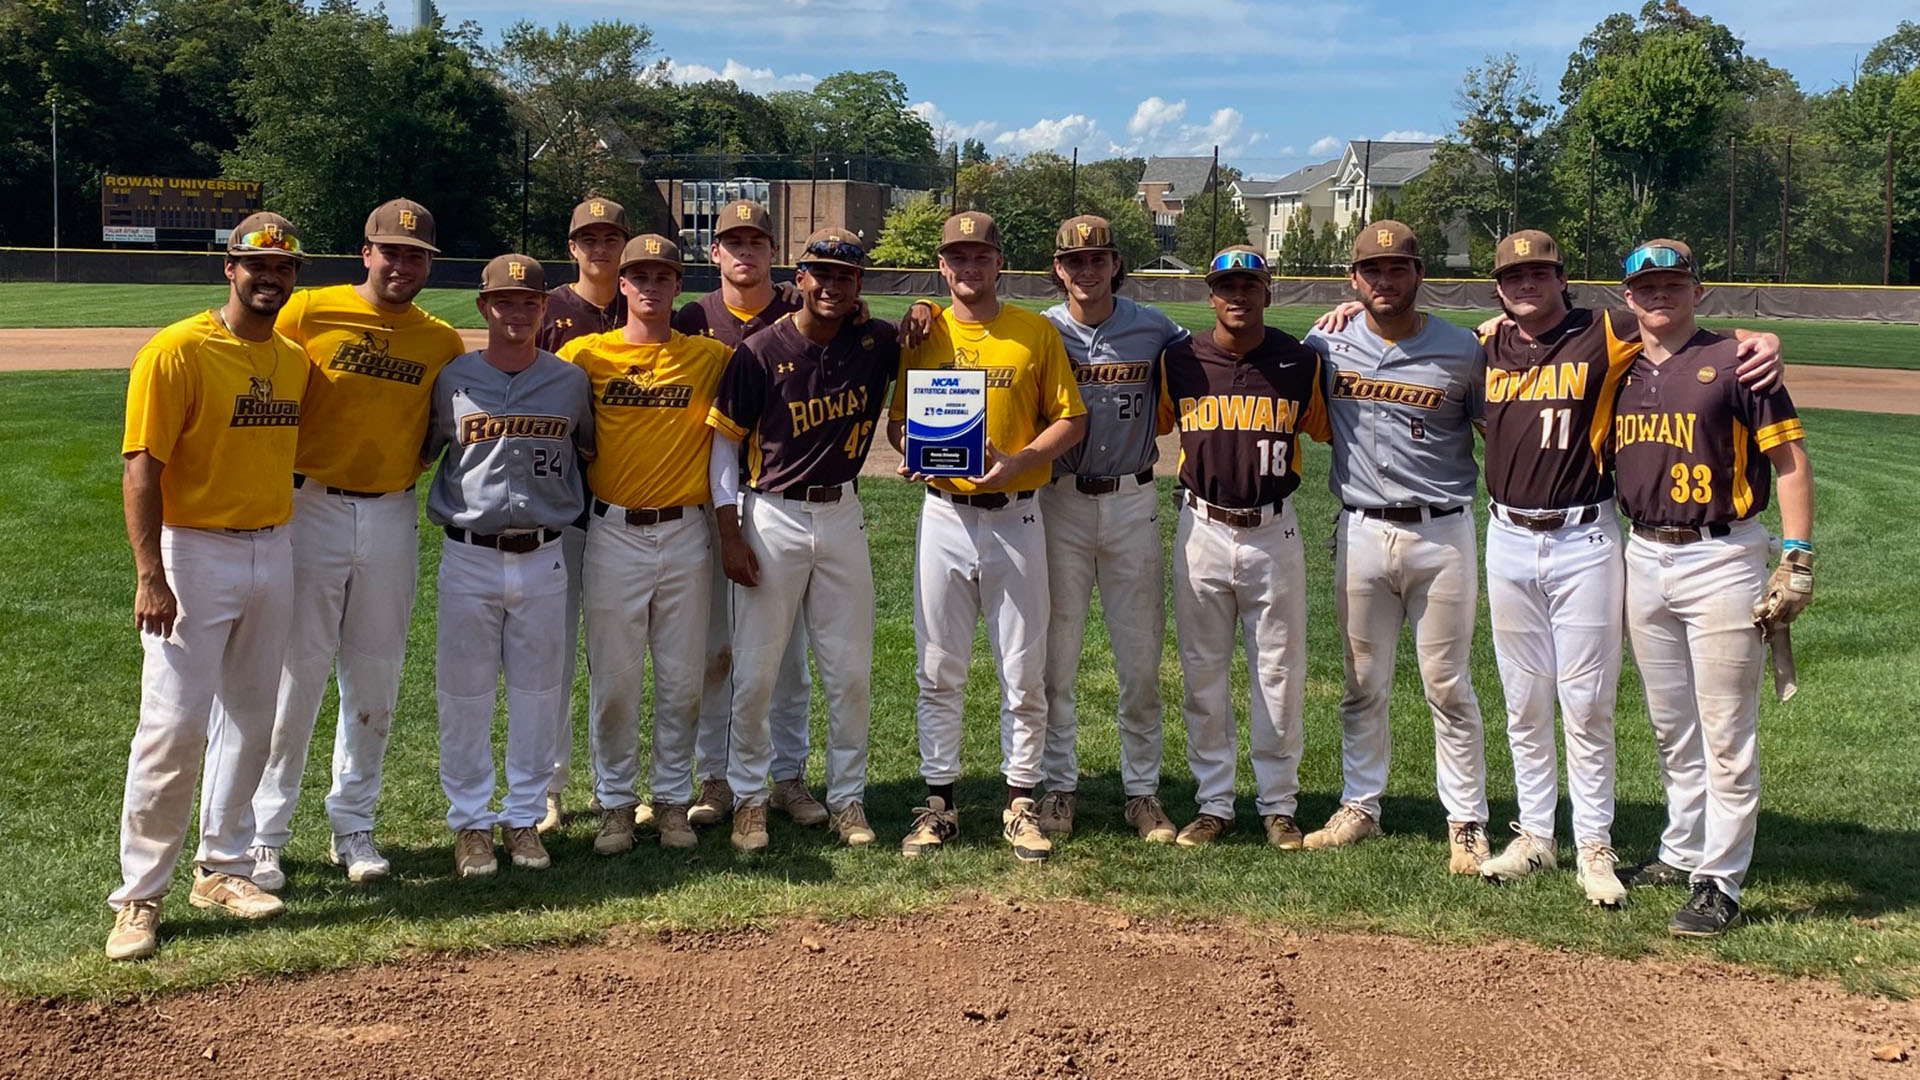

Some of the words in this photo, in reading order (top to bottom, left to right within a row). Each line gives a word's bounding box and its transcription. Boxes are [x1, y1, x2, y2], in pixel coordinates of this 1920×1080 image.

[105, 176, 164, 188] ROWAN
[168, 179, 260, 191] UNIVERSITY
[913, 387, 948, 395] STATISTICAL
[931, 378, 959, 387] NCAA
[1069, 360, 1152, 386] owan
[1331, 371, 1446, 410] Rowan
[1485, 362, 1589, 403] OWAN
[1117, 392, 1144, 420] 20
[1179, 395, 1299, 434] ROWAN
[461, 412, 569, 446] Rowan
[1540, 408, 1572, 450] 11
[1615, 413, 1697, 454] ROWAN
[533, 448, 563, 478] 24
[1257, 439, 1288, 477] 18
[1670, 462, 1713, 504] 33
